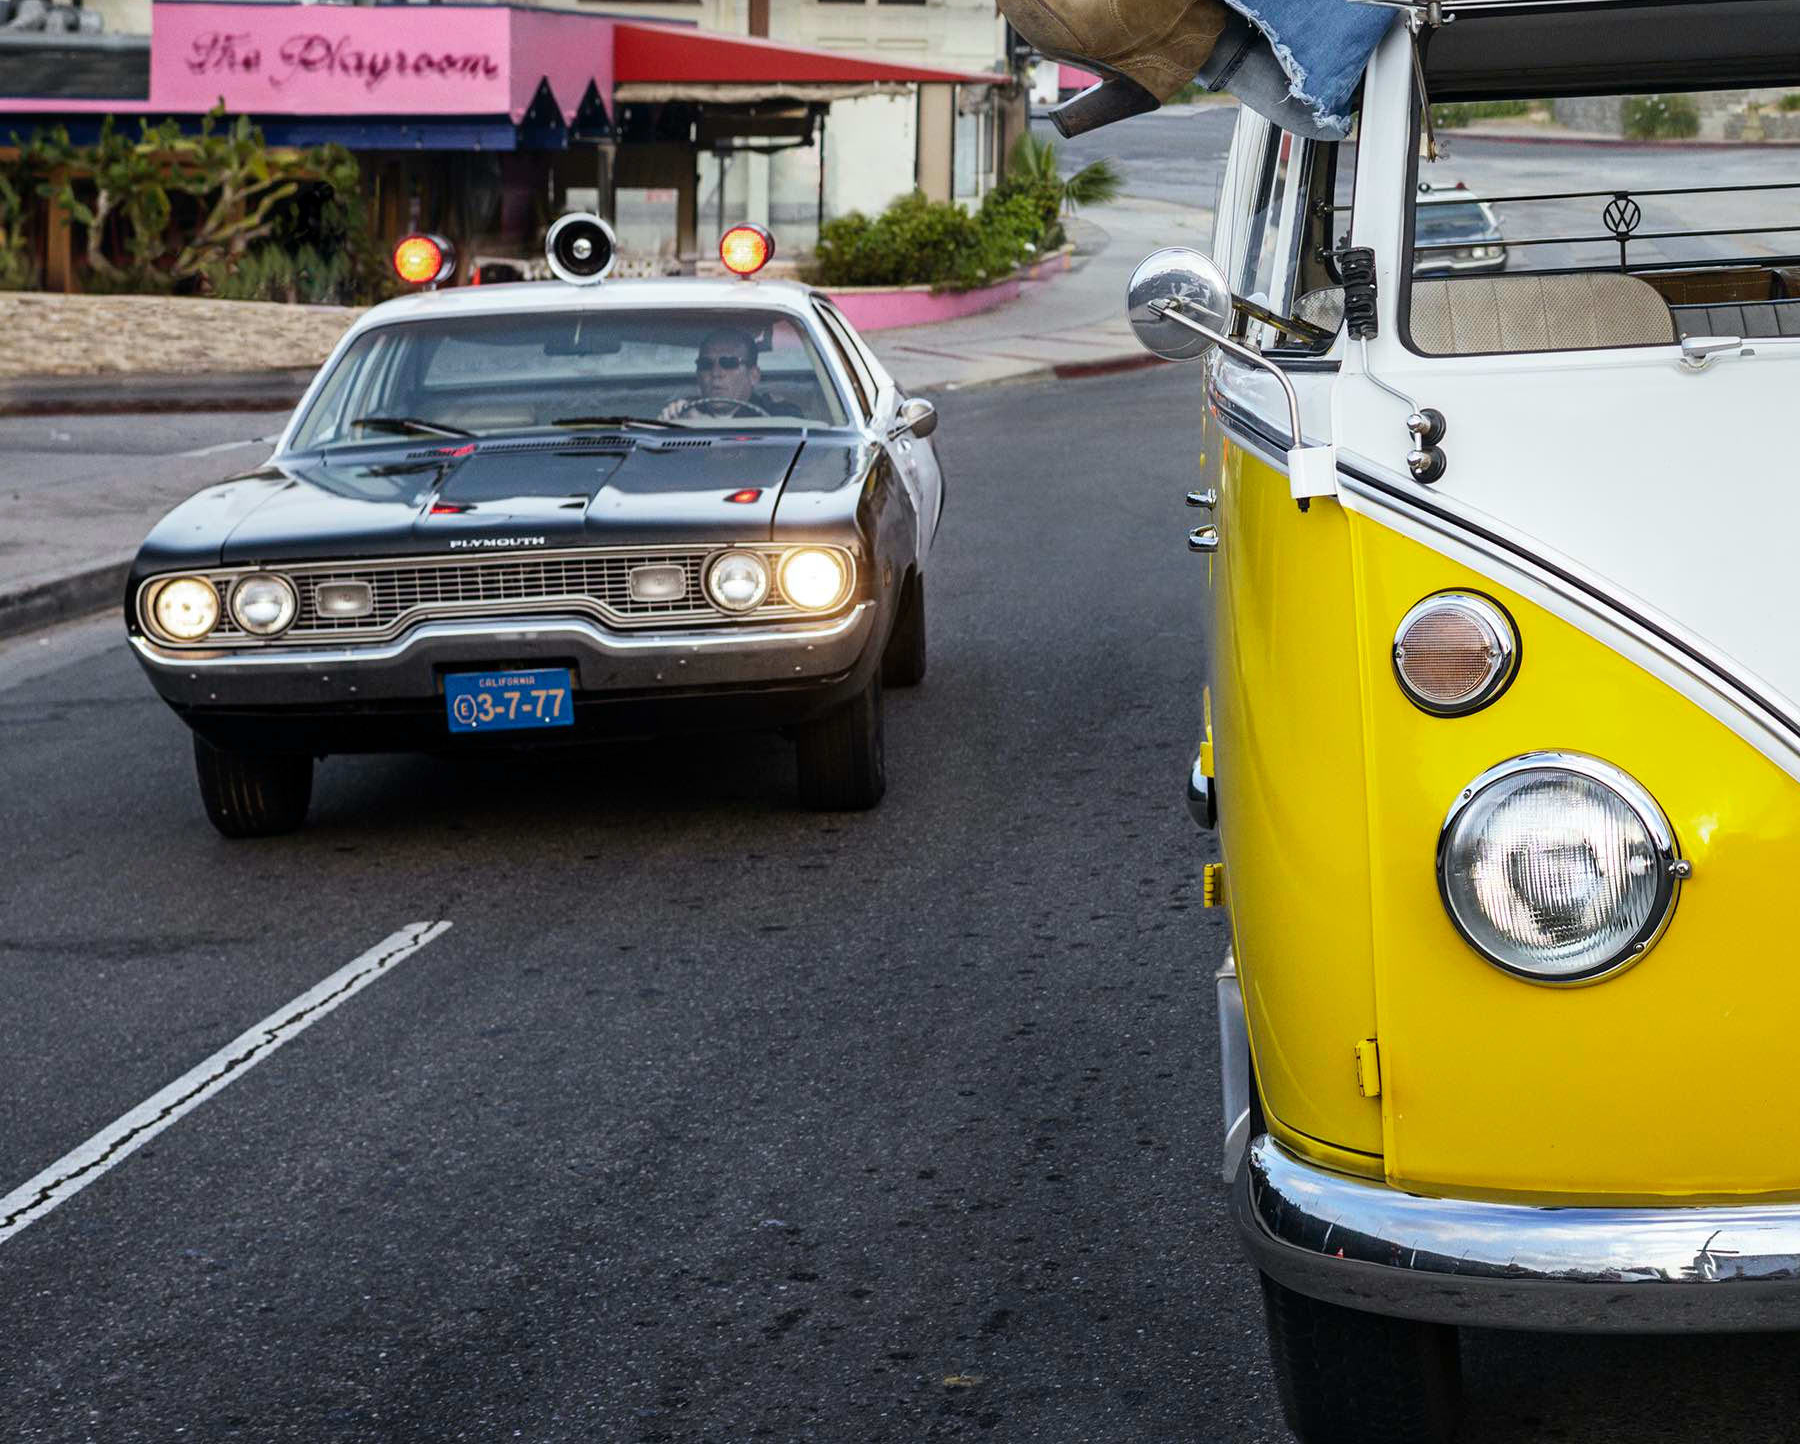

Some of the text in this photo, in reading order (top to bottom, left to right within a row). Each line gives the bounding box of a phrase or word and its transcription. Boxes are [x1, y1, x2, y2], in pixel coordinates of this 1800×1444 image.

[186, 33, 498, 92] The Playroom
[449, 536, 545, 548] PLYMOUTH
[479, 676, 535, 687] CALIFORNIA
